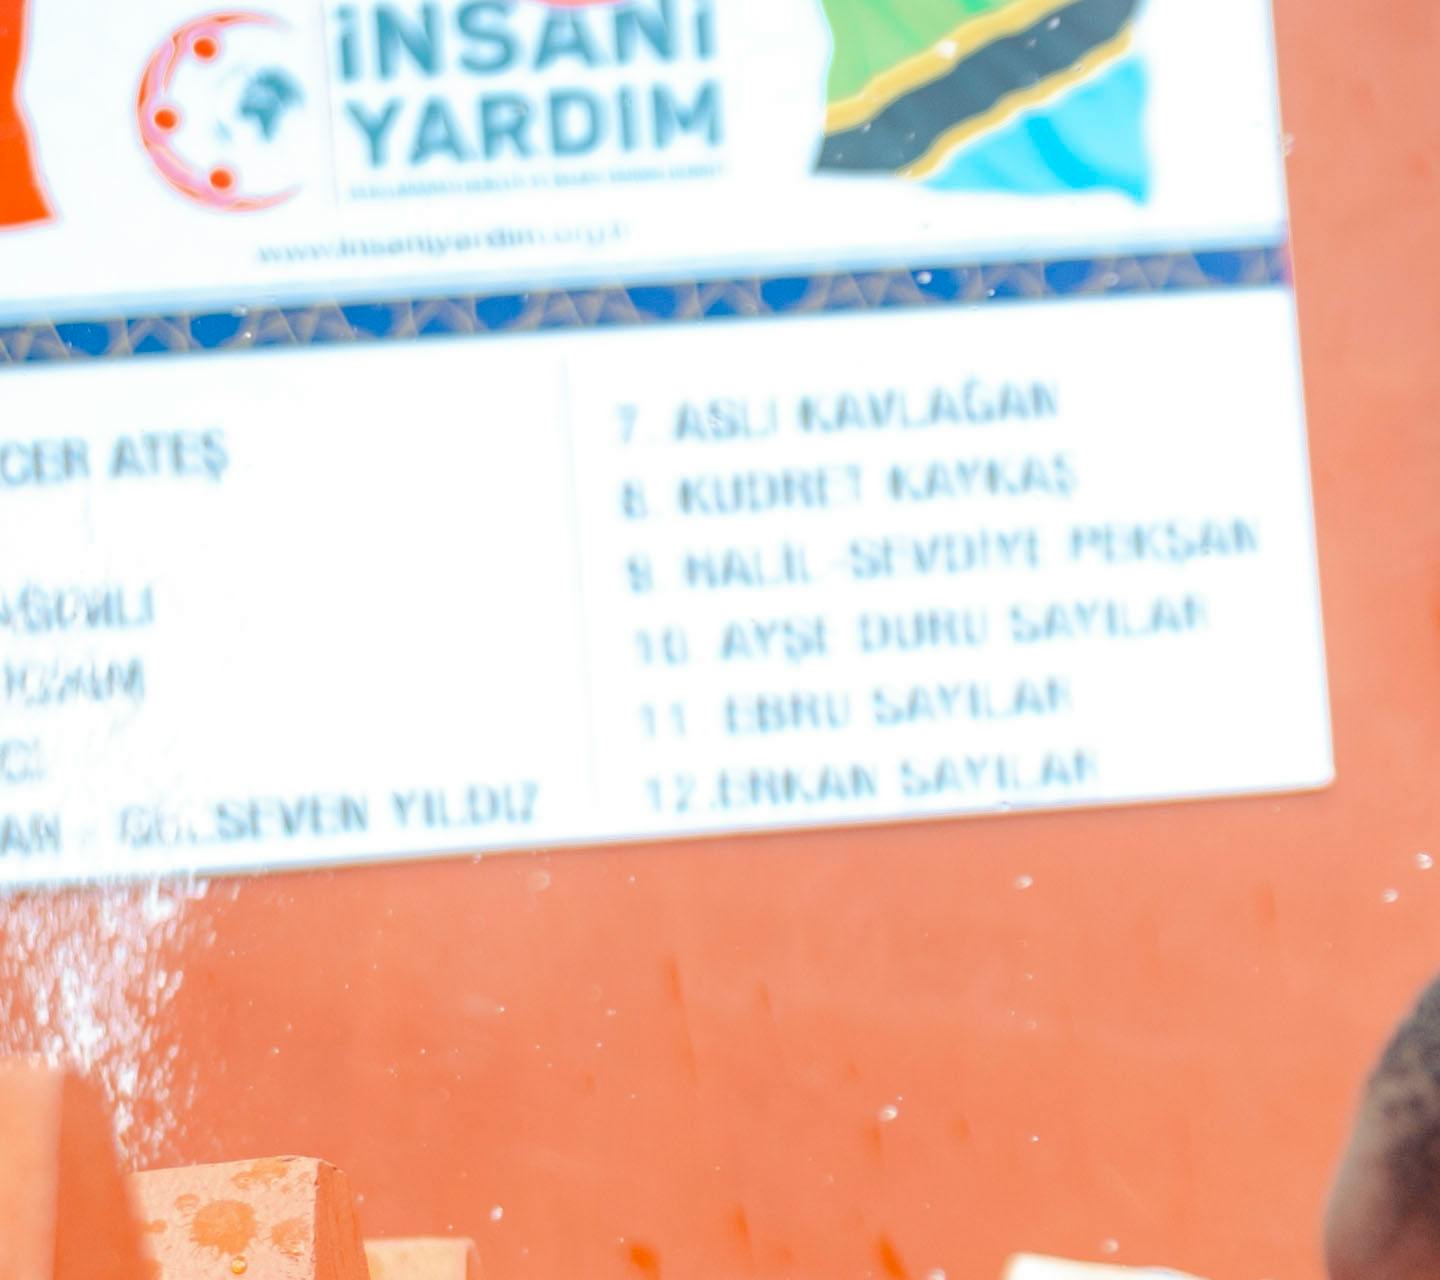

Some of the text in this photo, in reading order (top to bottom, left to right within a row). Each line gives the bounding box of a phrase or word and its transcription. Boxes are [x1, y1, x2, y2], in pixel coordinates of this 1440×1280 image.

[344, 78, 725, 168] YARDIM
[672, 397, 779, 444] ASLI
[107, 428, 230, 482] ATEŞ
[884, 450, 1078, 503] KAYKAŞ
[390, 781, 538, 828] YILDIZ
